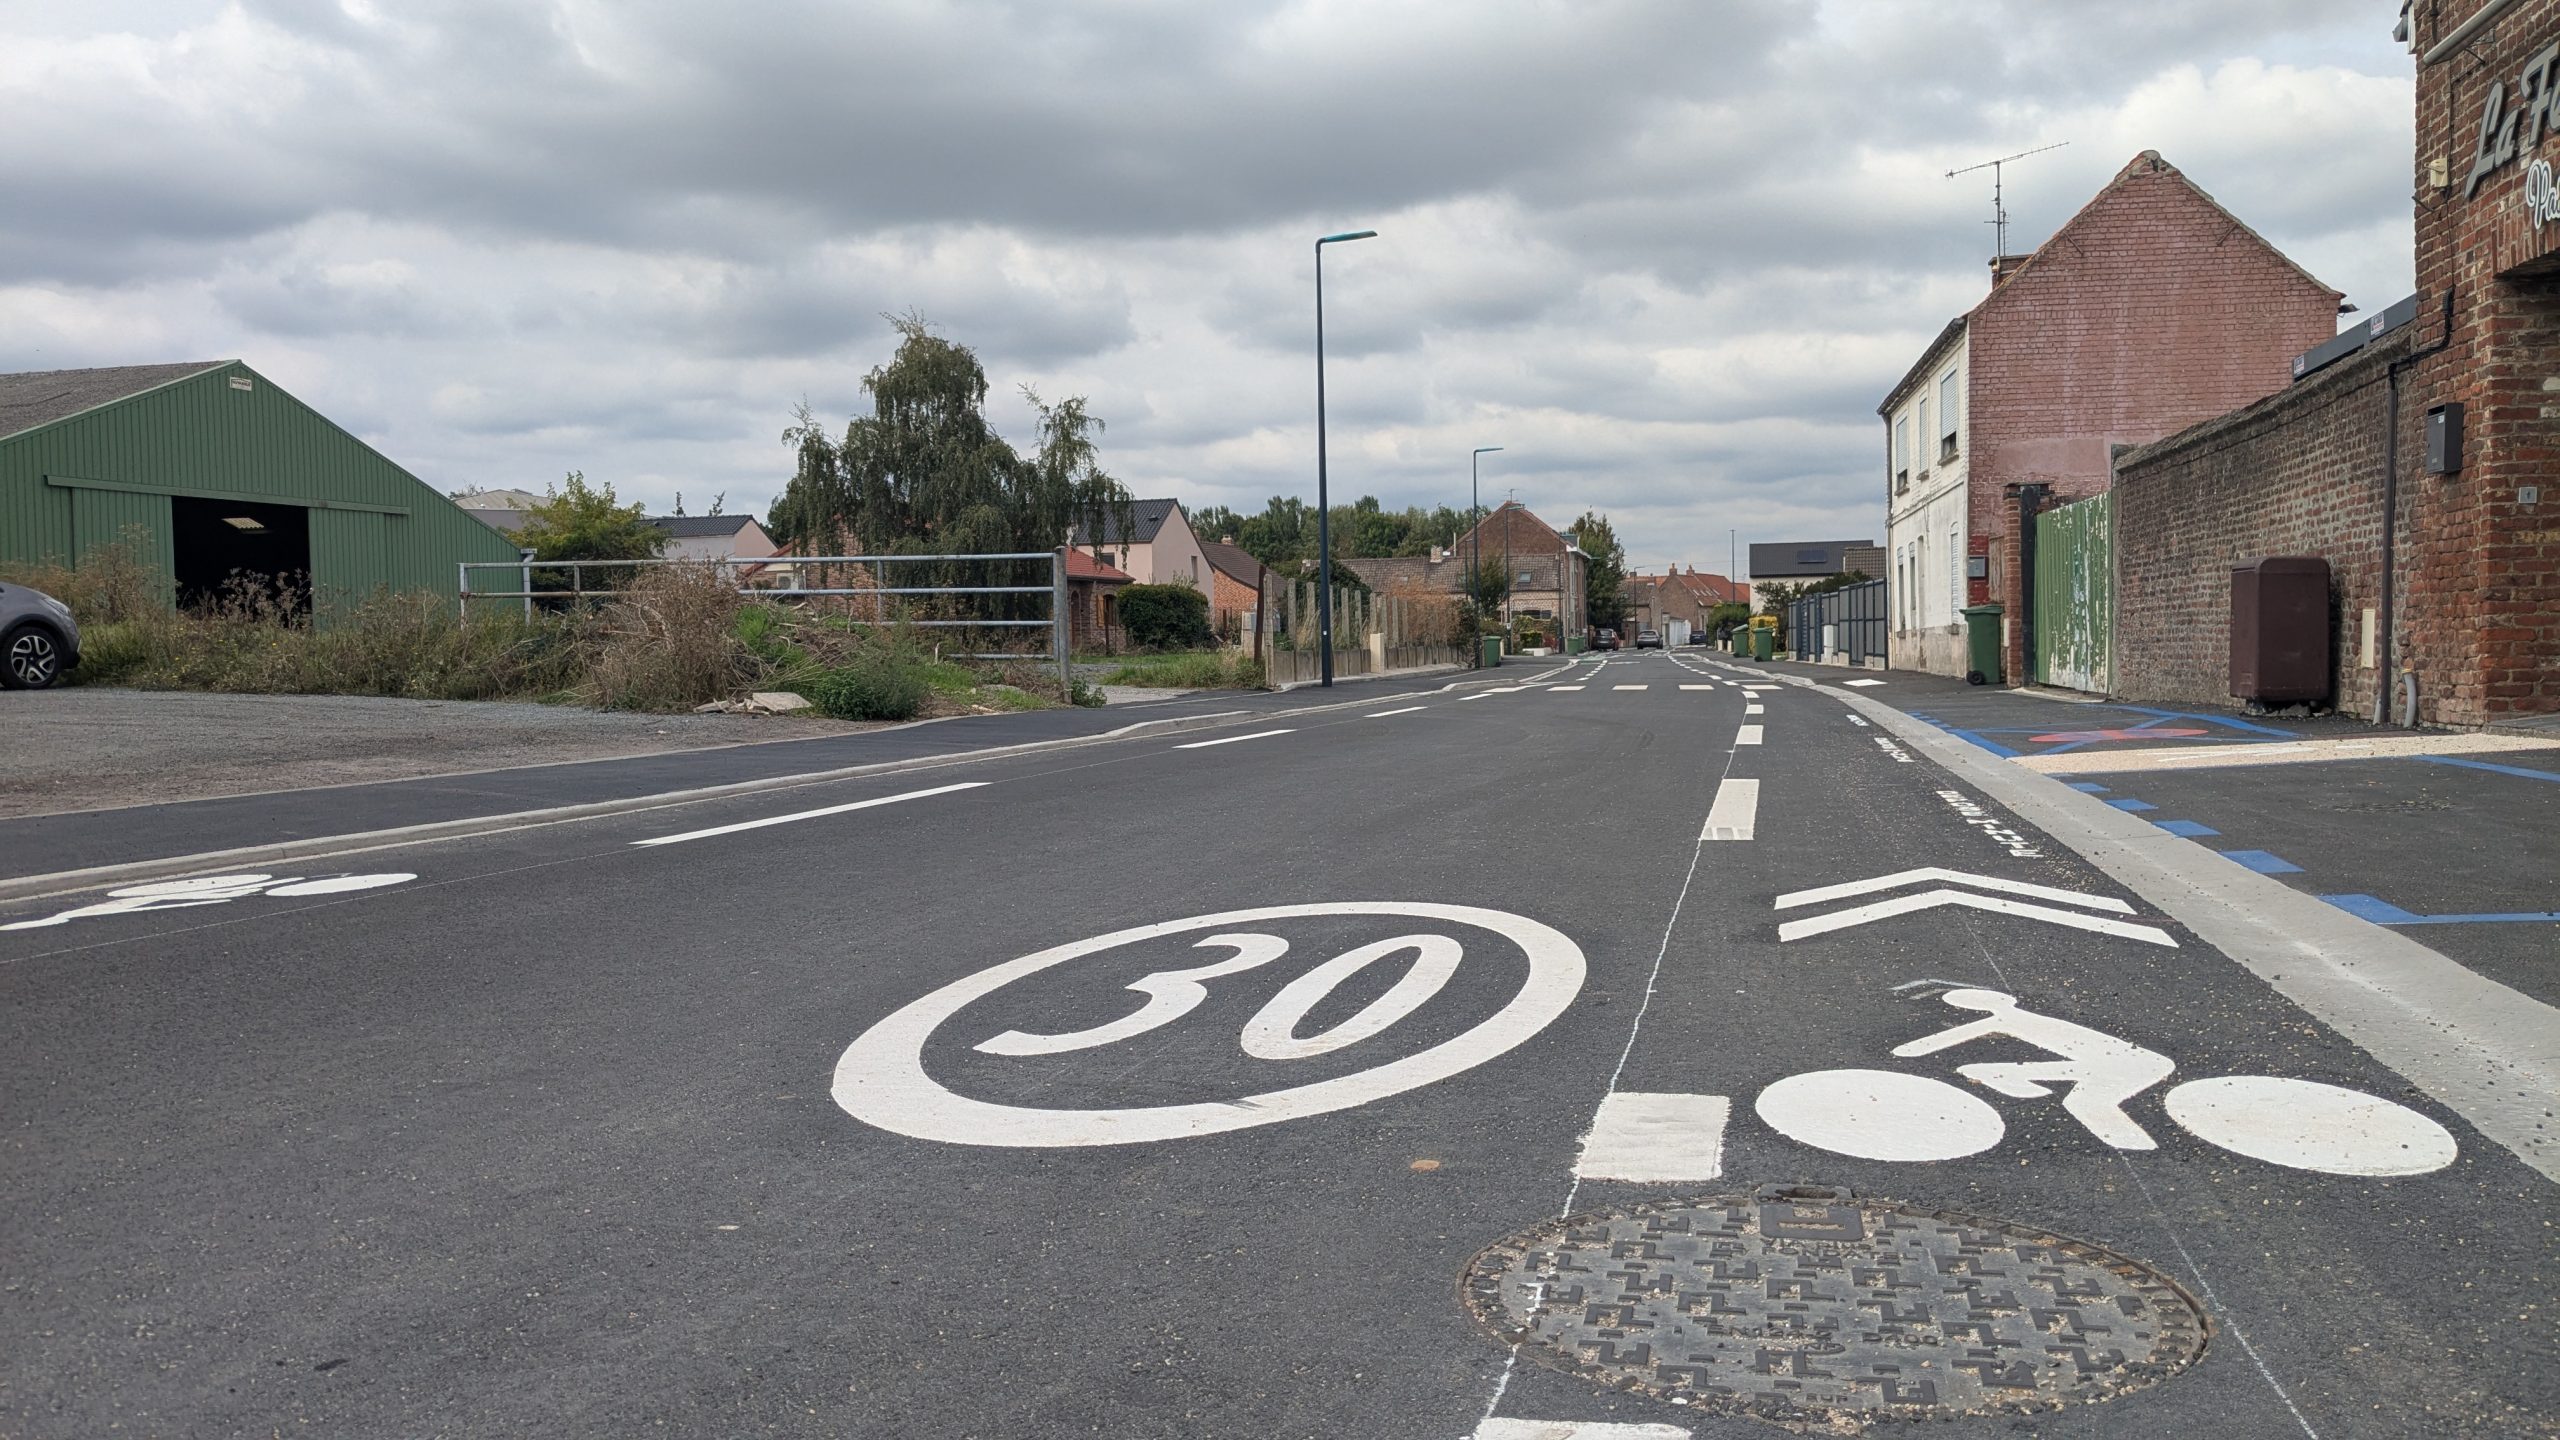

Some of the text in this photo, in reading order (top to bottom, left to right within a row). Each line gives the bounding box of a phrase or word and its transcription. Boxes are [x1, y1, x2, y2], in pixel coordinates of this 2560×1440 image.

[2464, 80, 2518, 199] La
[2525, 158, 2560, 231] Pa
[972, 932, 1464, 1060] 30
